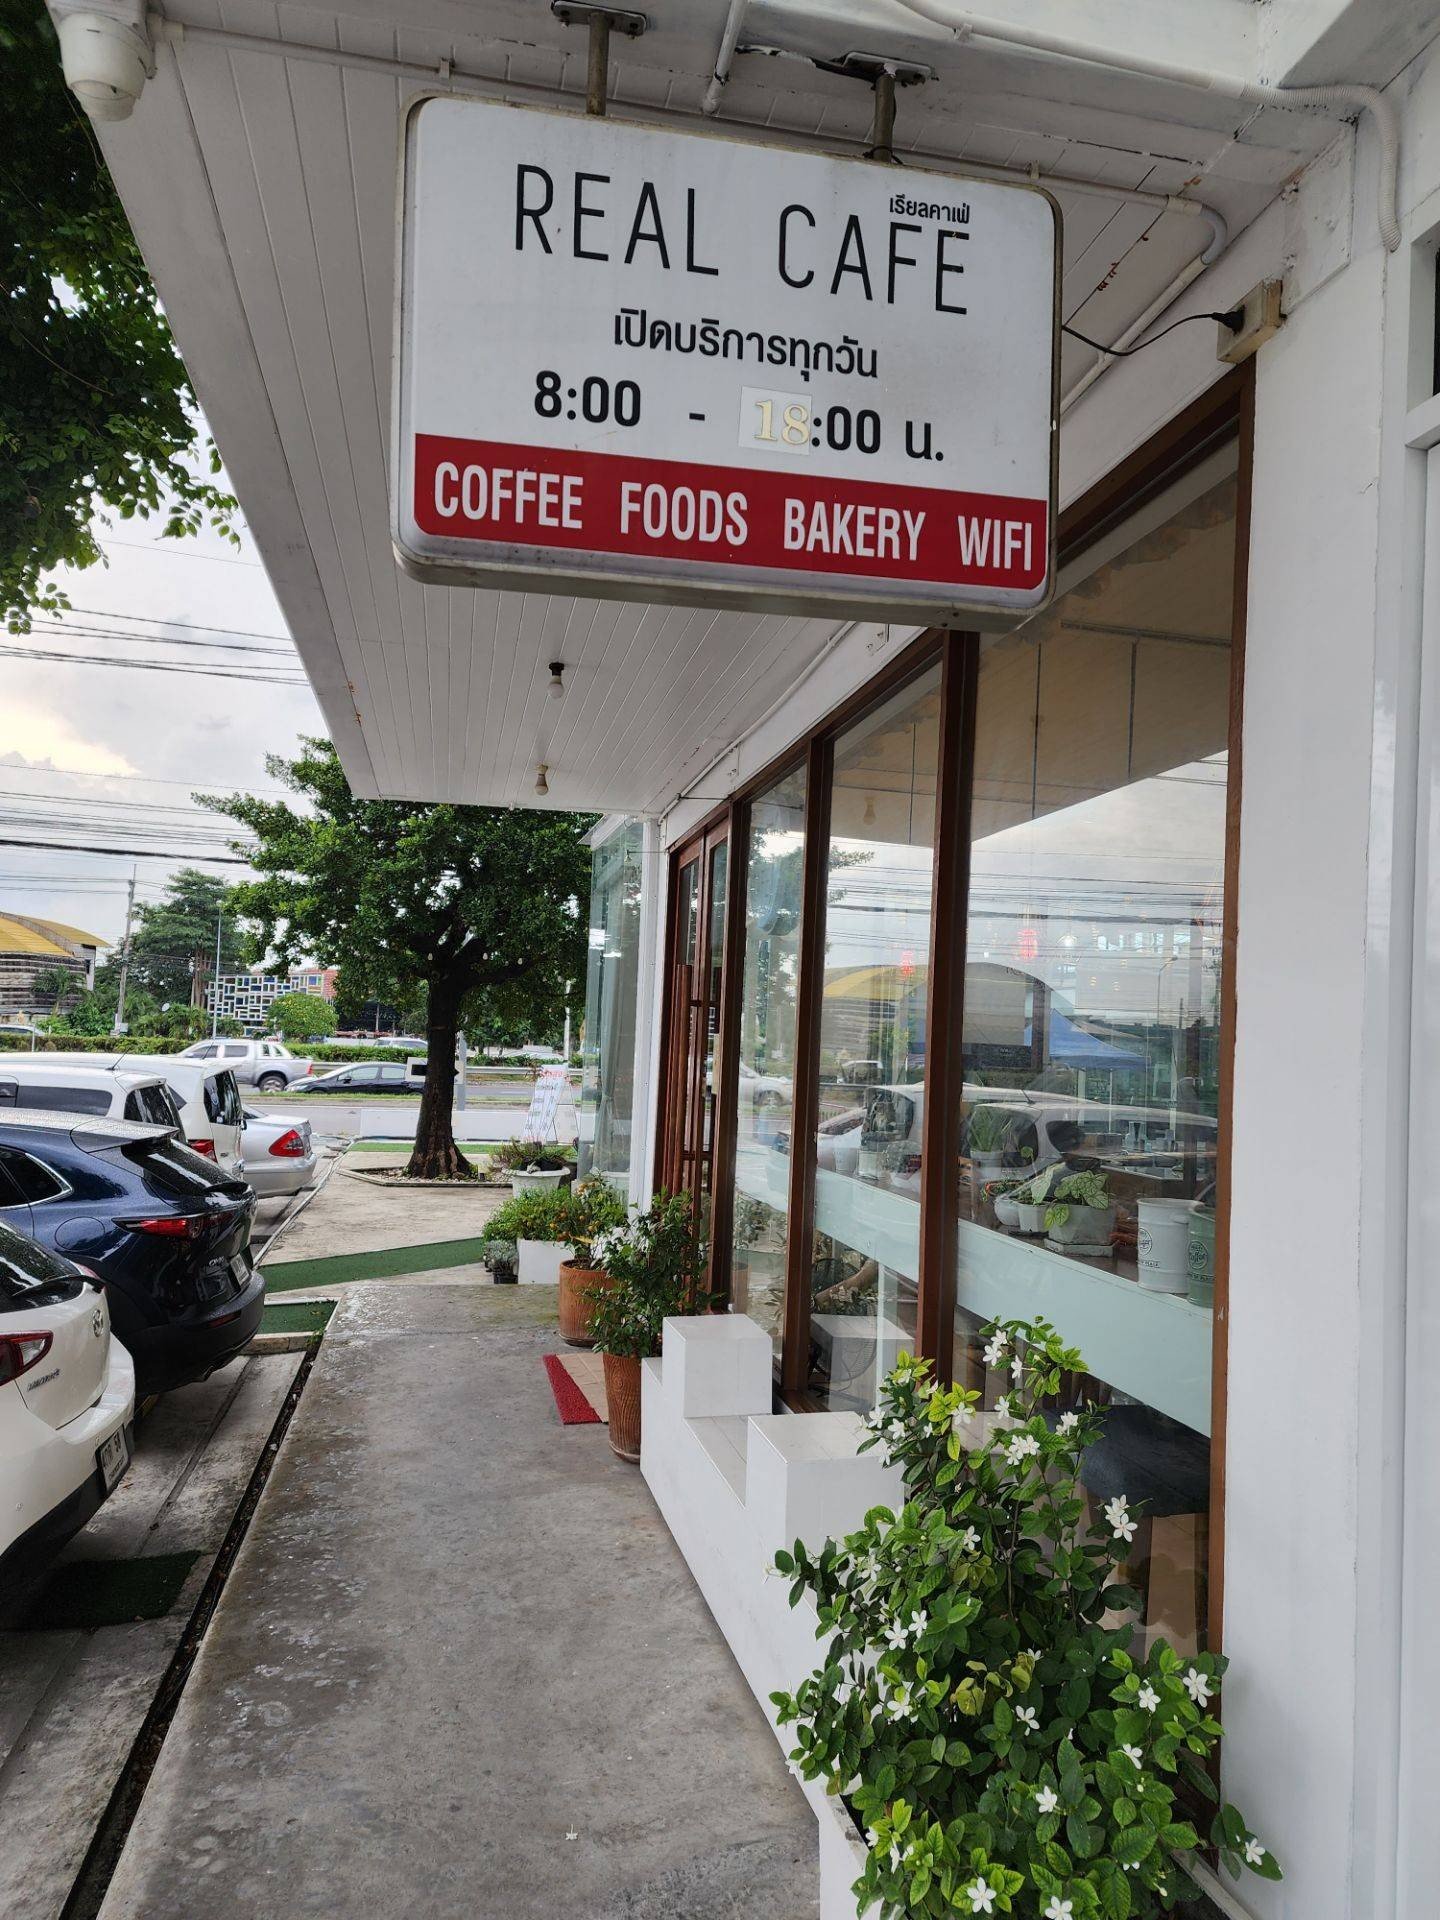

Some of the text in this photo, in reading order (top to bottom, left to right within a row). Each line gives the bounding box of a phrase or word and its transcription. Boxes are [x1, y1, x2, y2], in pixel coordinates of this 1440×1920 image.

[515, 163, 970, 315] REAL CAFE
[889, 193, 971, 224] เรียลคาเฟ่
[614, 307, 878, 382] เปิดบริการทุกวัน
[534, 370, 944, 462] 8:00 - 18:00 น.
[434, 461, 1032, 571] COFFEE FOODS BAKERY WIFI
